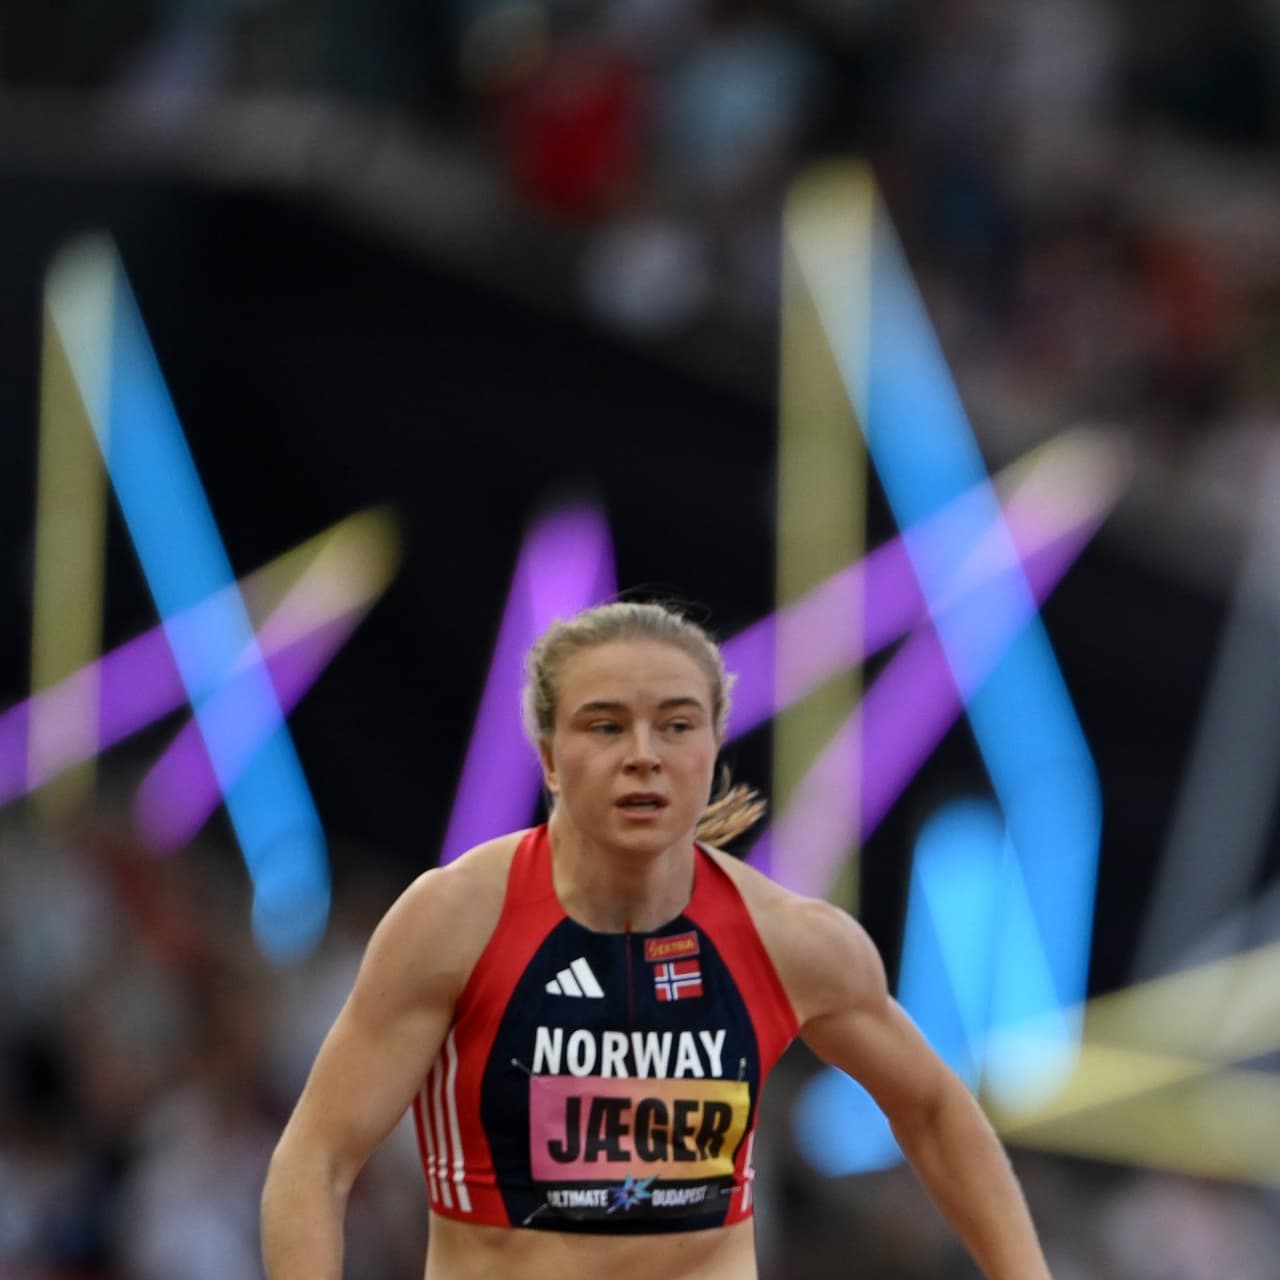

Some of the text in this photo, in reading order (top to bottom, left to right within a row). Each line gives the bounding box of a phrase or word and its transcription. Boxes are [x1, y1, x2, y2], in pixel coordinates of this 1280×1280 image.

[532, 1026, 727, 1079] NORWAY
[546, 1096, 734, 1164] JÆGER
[547, 1187, 609, 1208] ULTIMATE
